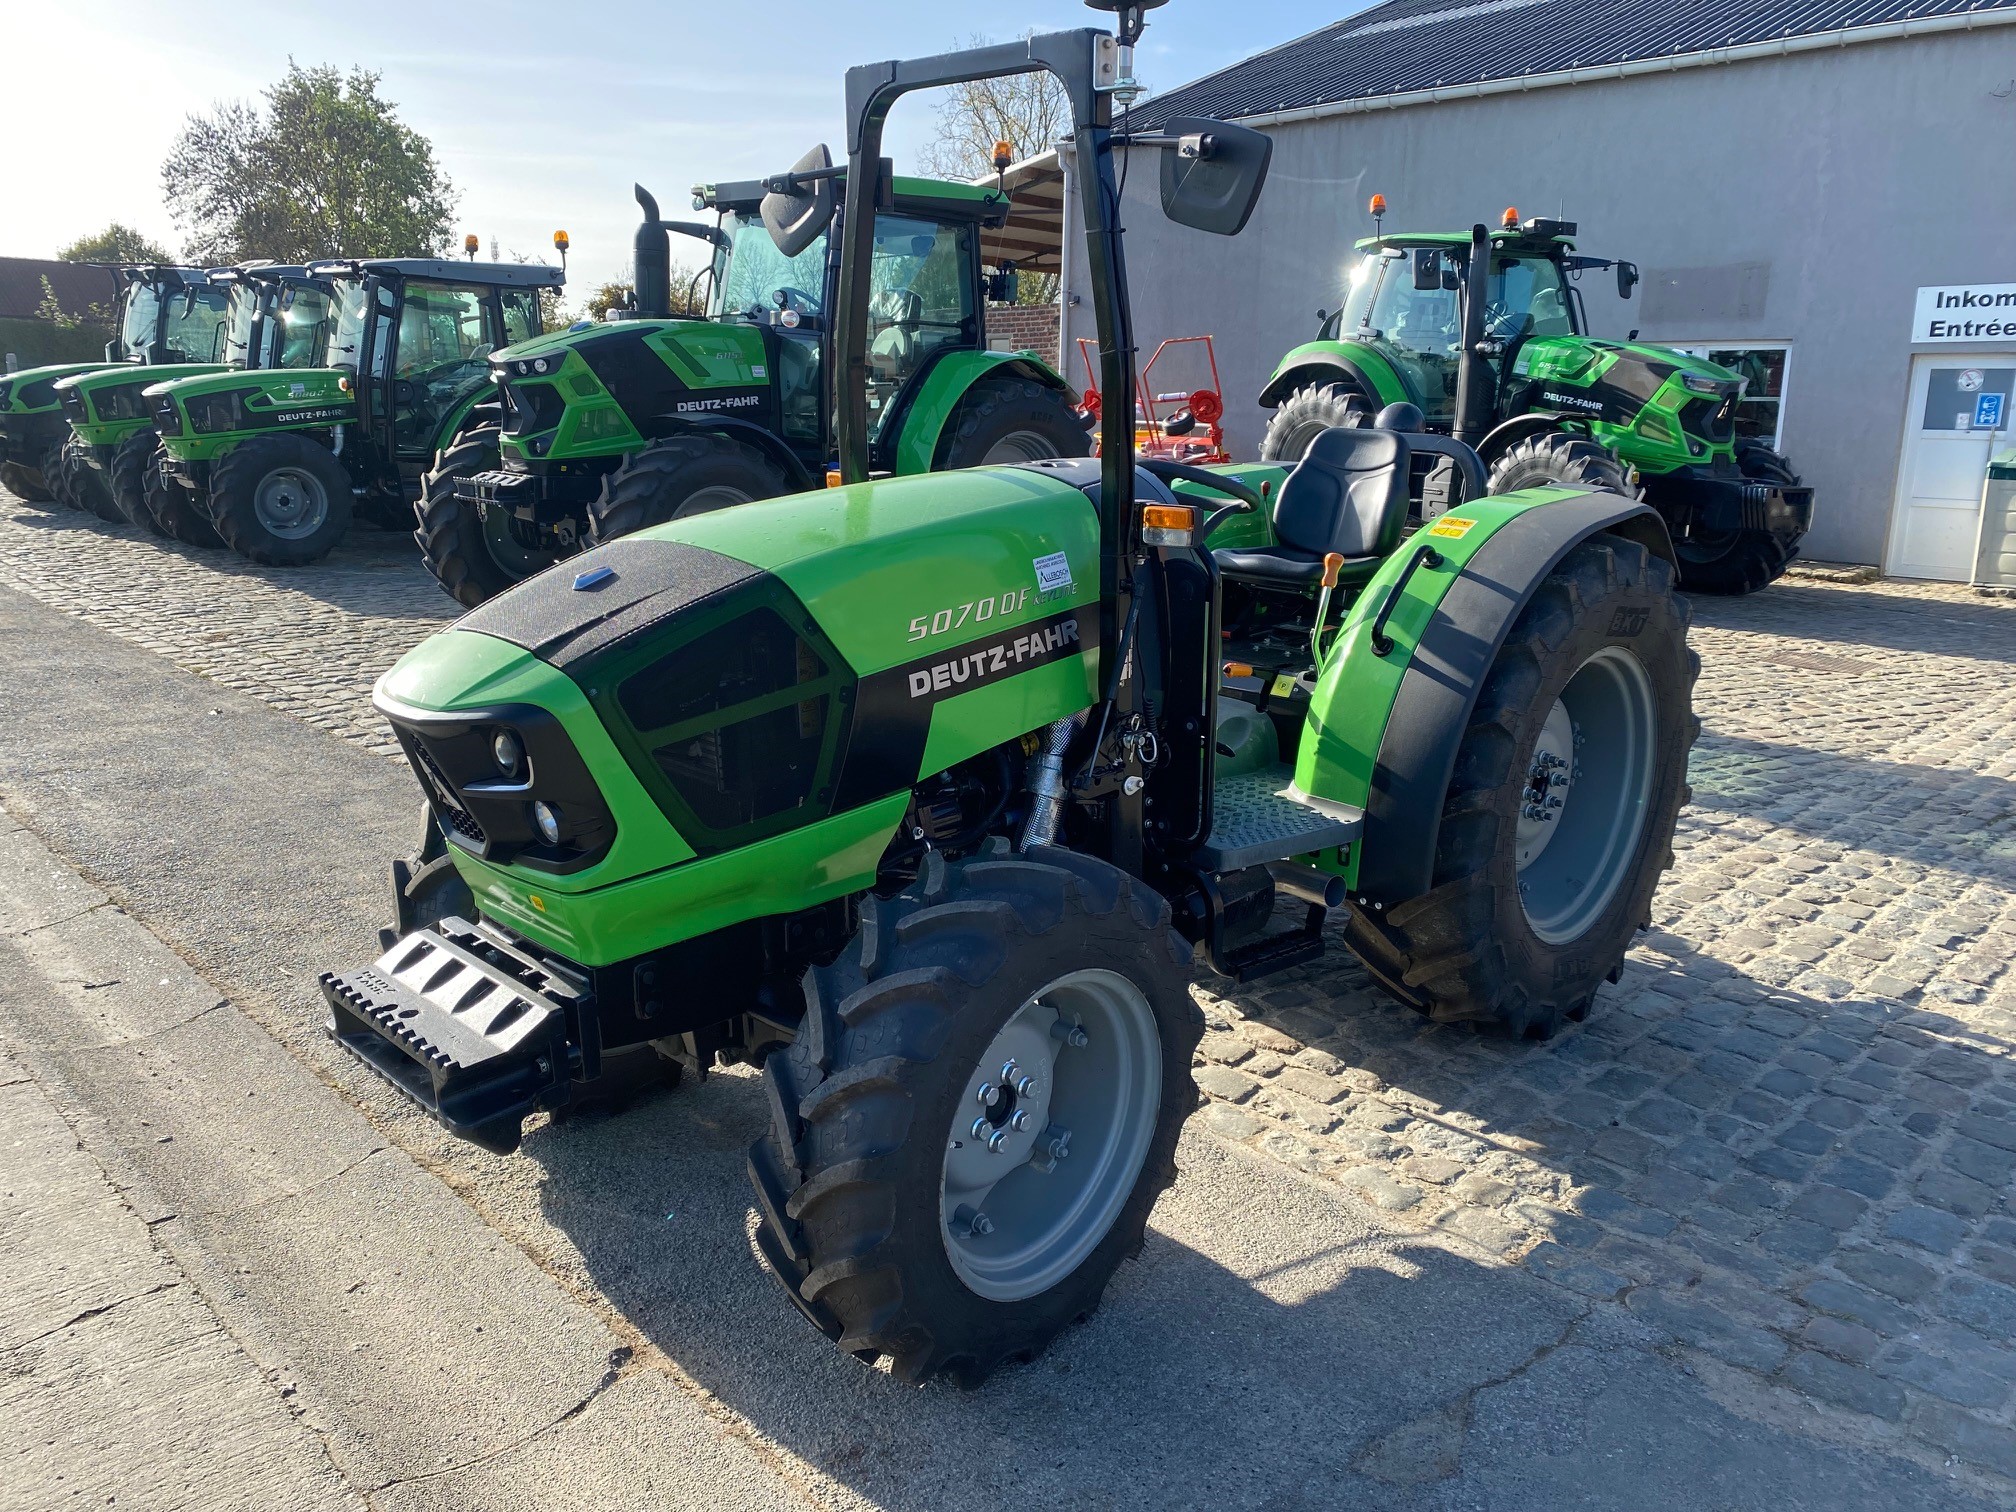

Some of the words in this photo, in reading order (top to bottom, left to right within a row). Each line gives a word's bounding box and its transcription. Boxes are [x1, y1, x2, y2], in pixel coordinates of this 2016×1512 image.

[1936, 290, 2016, 308] Inkom
[1929, 318, 2016, 338] Entrée
[677, 395, 760, 412] DEUTZ-FAHR
[1543, 391, 1604, 411] DEUTZ-FAHR
[277, 408, 342, 422] DEUTZ-FAHR
[1609, 609, 1649, 635] BKT
[908, 619, 1080, 698] DEUTZ-FAHR
